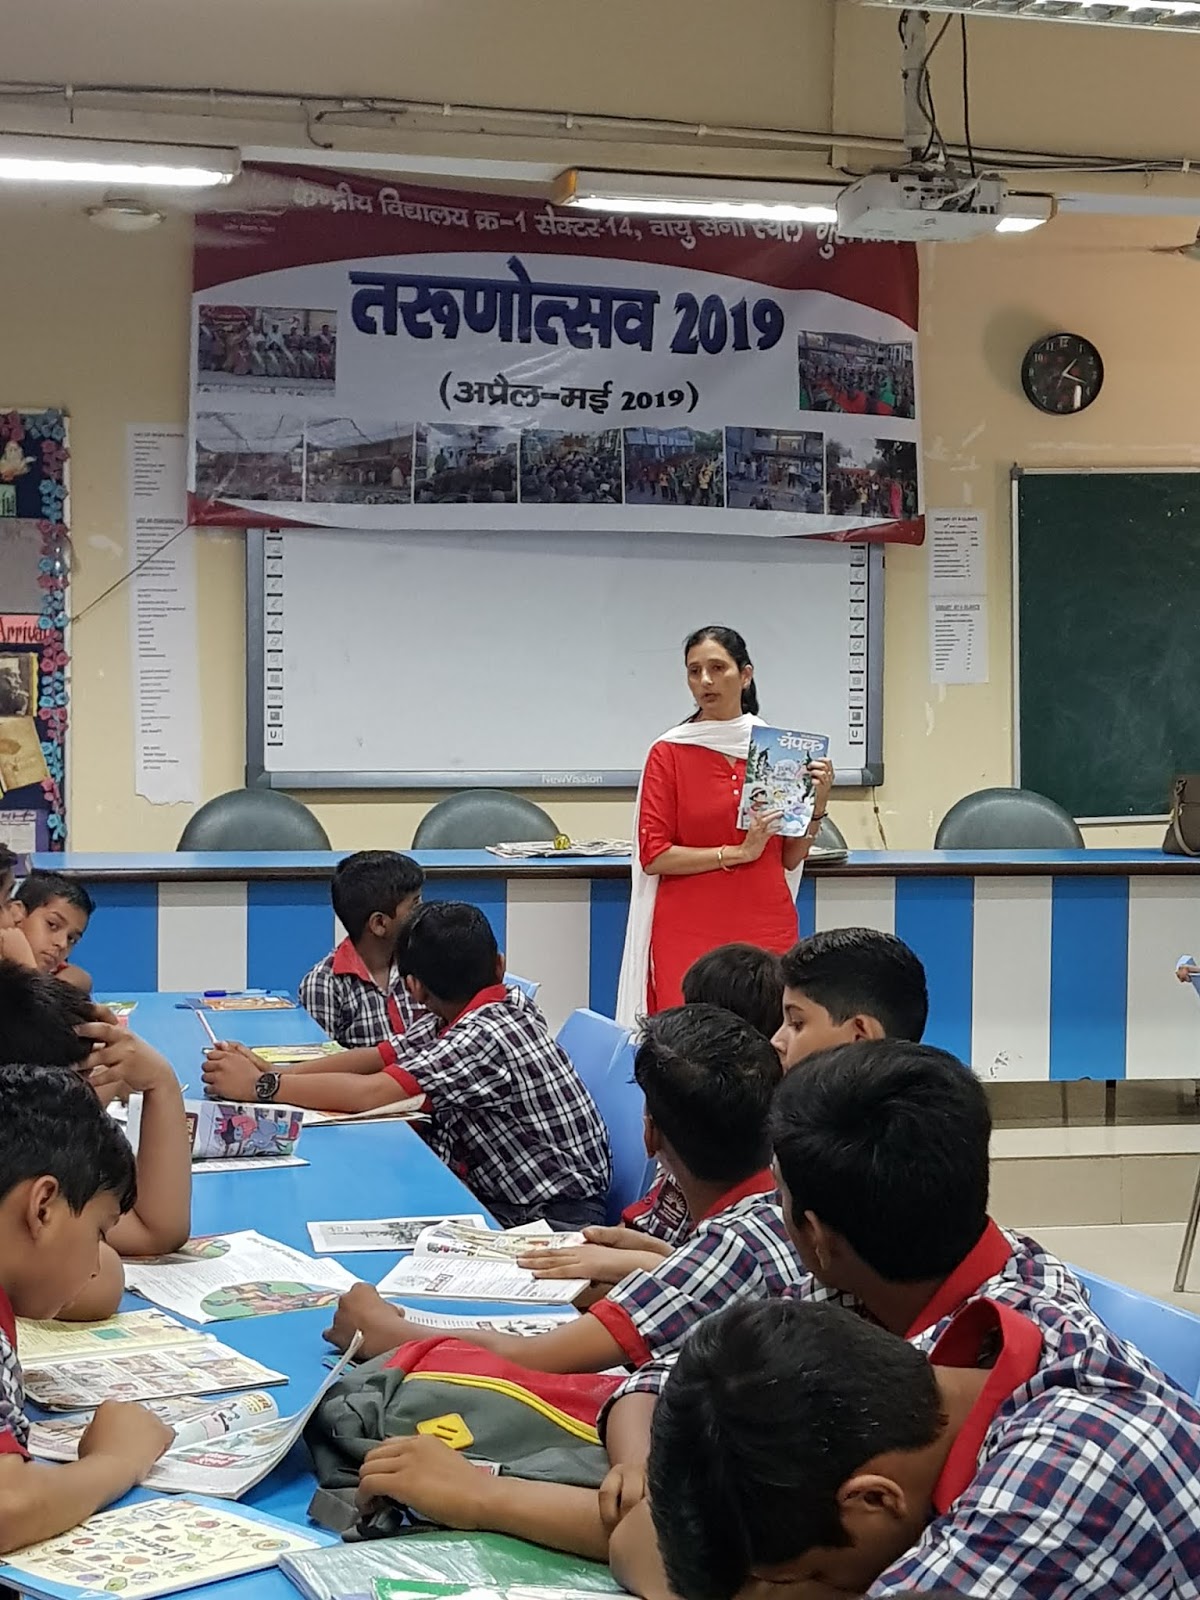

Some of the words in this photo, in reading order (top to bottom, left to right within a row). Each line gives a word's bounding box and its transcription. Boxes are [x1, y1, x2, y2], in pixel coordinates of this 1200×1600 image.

[378, 187, 469, 228] विद्यालय
[475, 208, 527, 233] क्र-1
[649, 217, 697, 250] वायु
[697, 217, 746, 237] सना
[348, 255, 661, 352] तरूणोत्सव
[669, 292, 785, 355] 2019
[621, 381, 699, 414] 2019)
[777, 732, 824, 753] चंपक
